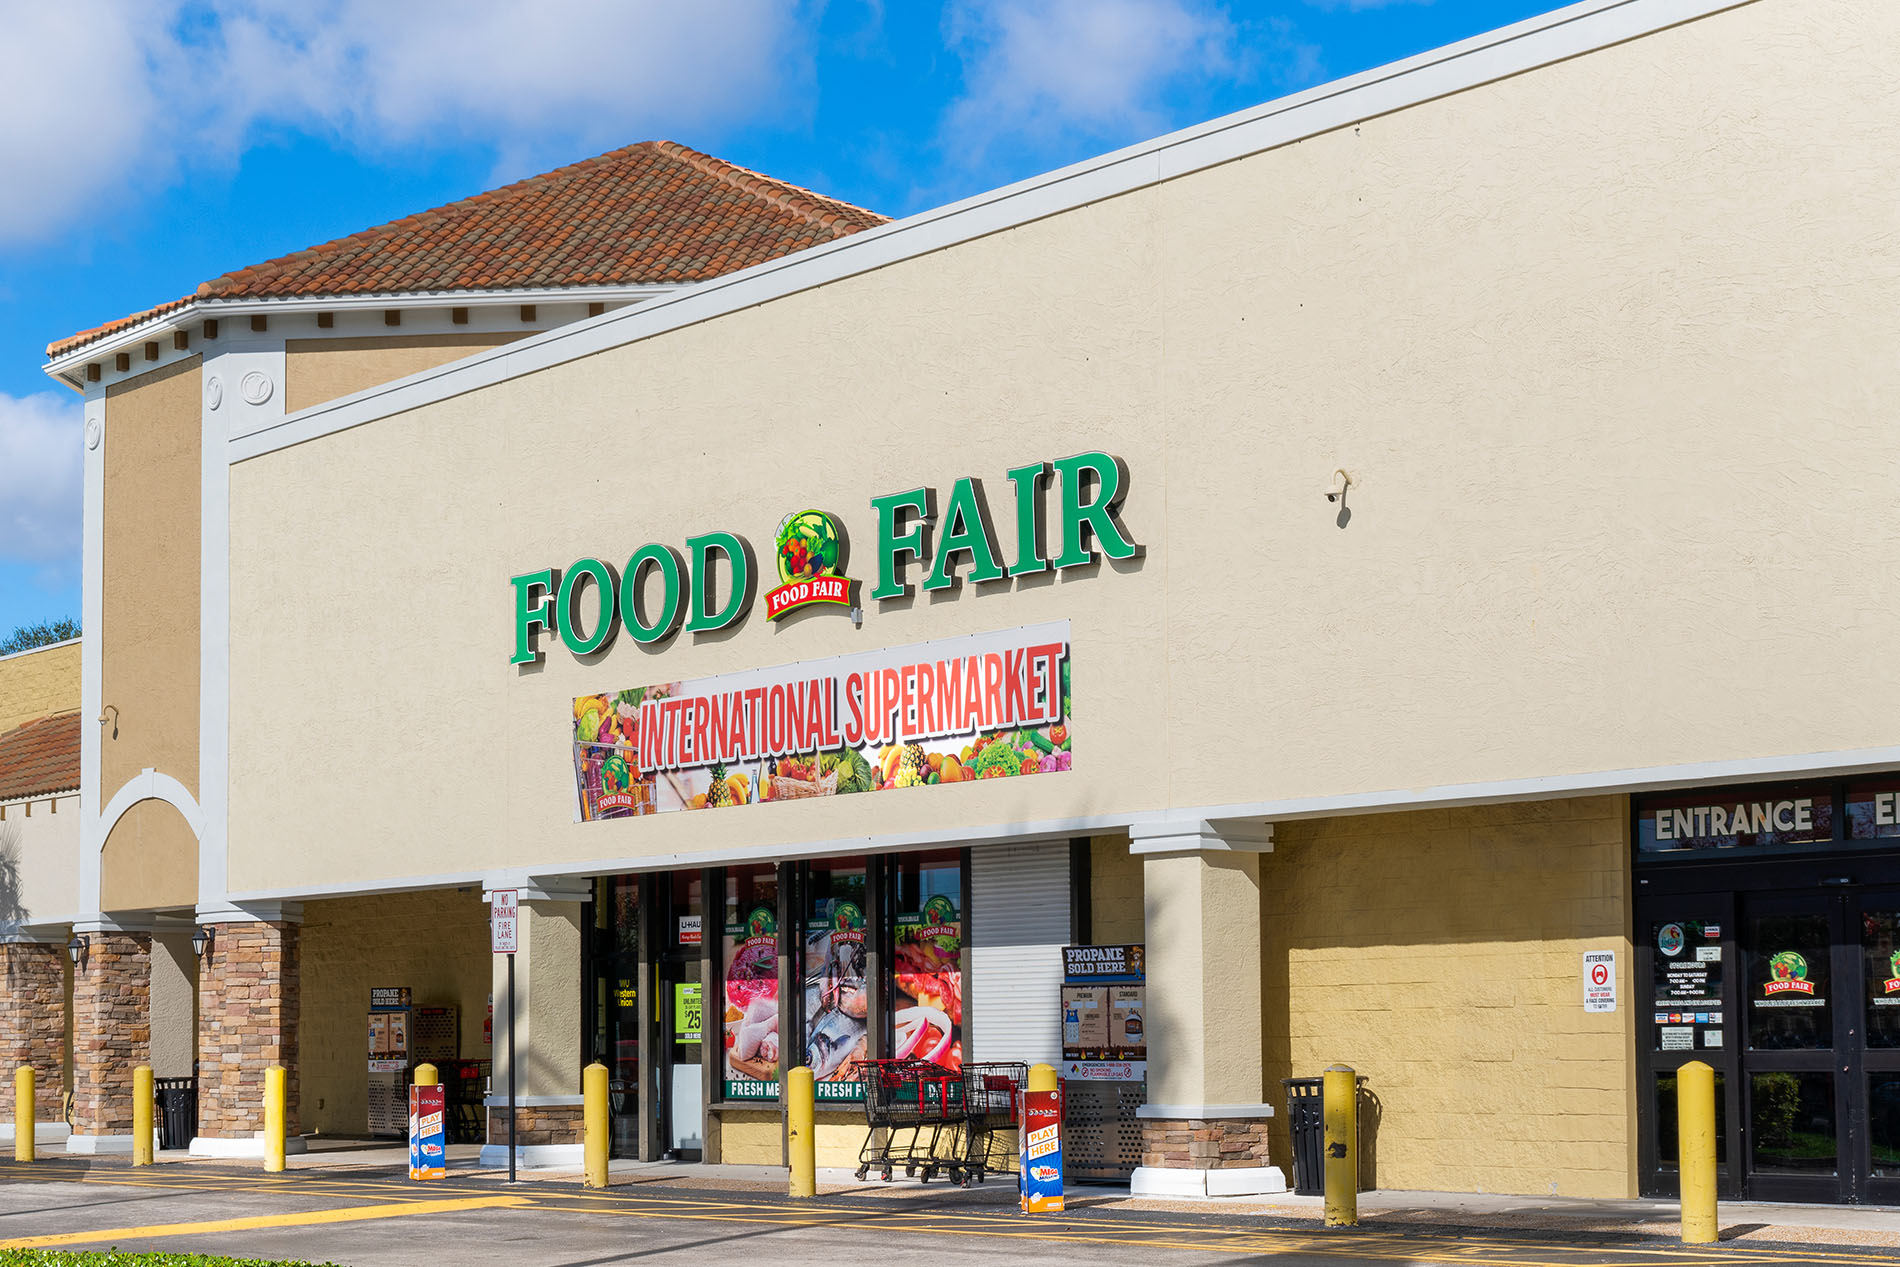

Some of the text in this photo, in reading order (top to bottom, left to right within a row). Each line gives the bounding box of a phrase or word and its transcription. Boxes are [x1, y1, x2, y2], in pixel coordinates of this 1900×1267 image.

[510, 450, 1138, 665] FOOD FAIR
[772, 581, 842, 611] FOOD FAIR
[639, 641, 1064, 770] INTERNATIONAL SUPERMARKET
[600, 794, 632, 809] FOOD FAIR
[1655, 798, 1813, 840] ENTRANCE
[501, 893, 509, 906] NO
[494, 906, 516, 919] PARKING
[498, 921, 511, 930] FIRE
[681, 921, 701, 929] U-HAU
[923, 926, 954, 937] FOOD FAIR
[497, 930, 512, 940] LANE
[833, 931, 862, 942] FOOD FAIR
[747, 936, 776, 948] FOOD FAIR
[1066, 947, 1125, 962] PROPANE
[1586, 954, 1613, 963] ATTENTION
[1068, 962, 1126, 974] SOLD HERE
[1768, 982, 1809, 992] FOOD FAIR
[1889, 980, 1900, 989] FO
[372, 989, 399, 998] PROPANE
[613, 988, 636, 998] Western
[618, 998, 633, 1007] Union
[685, 1010, 701, 1029] $25
[731, 1082, 779, 1096] FRESH ME
[818, 1082, 852, 1097] FRESH
[421, 1112, 440, 1126] PLAY
[421, 1124, 440, 1137] HERE
[1030, 1126, 1055, 1143] PLAY
[1031, 1140, 1056, 1157] HERE
